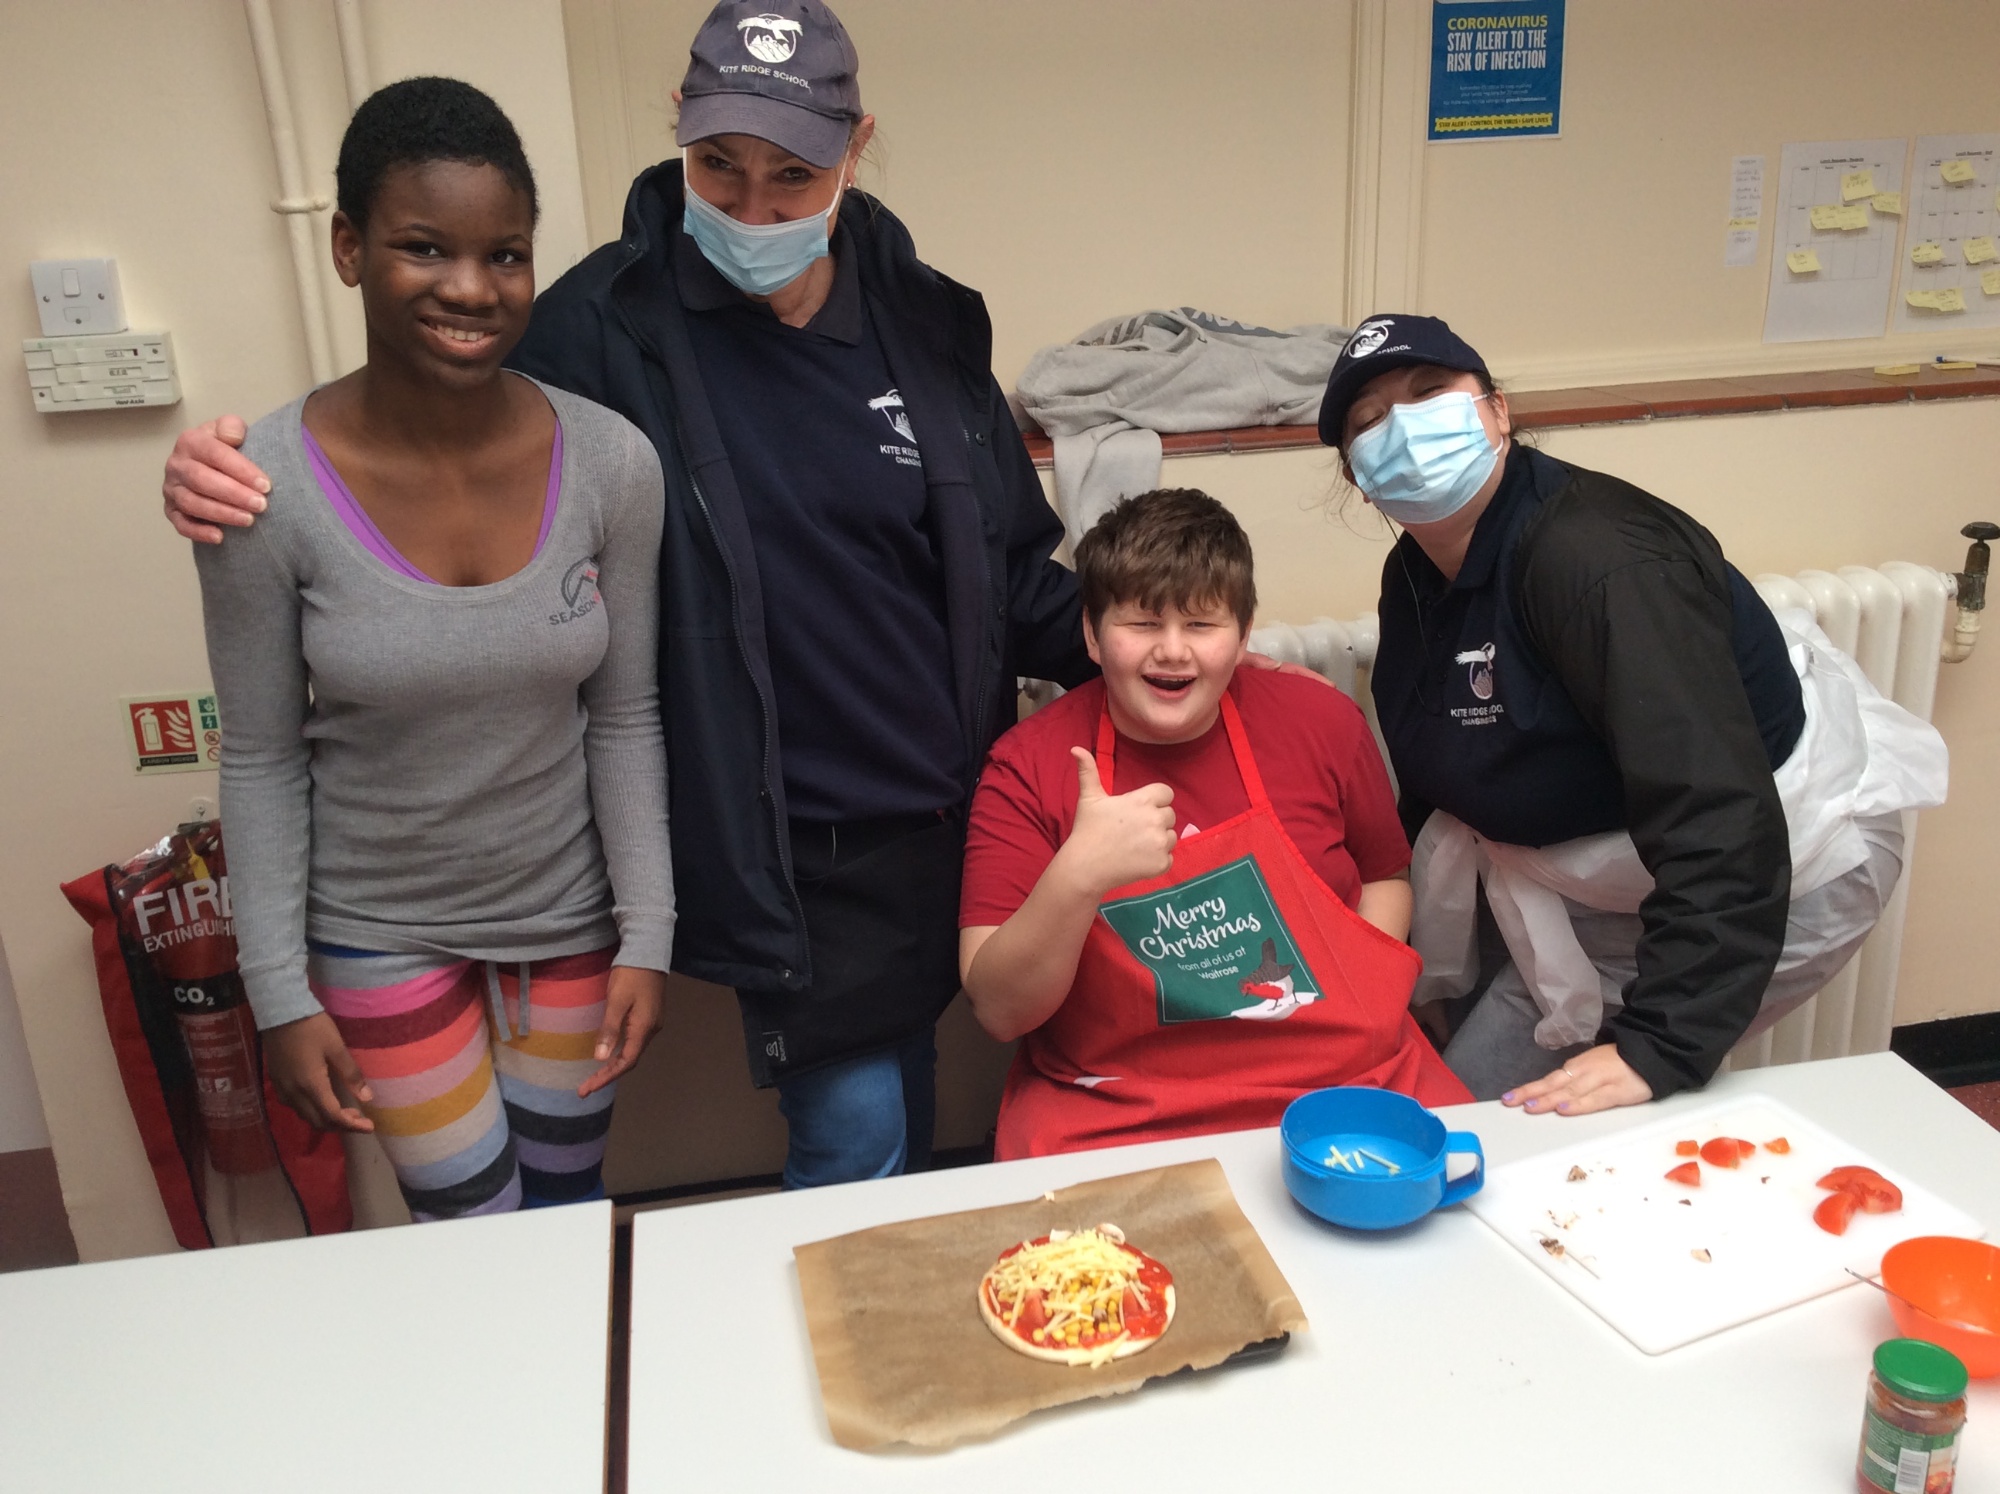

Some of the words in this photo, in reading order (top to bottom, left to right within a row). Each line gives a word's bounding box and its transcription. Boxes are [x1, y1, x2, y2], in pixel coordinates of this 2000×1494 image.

[1447, 15, 1548, 31] CORONAVIRUS
[1447, 32, 1474, 51] STAY
[1475, 31, 1508, 50] ALERT
[1511, 30, 1525, 49] TO
[1527, 29, 1547, 48] THE
[1446, 52, 1472, 72] RISK
[1474, 51, 1488, 71] OF
[1490, 49, 1546, 70] INFECTION
[719, 65, 739, 74] KITE
[741, 64, 771, 76] RIDGE
[773, 70, 810, 89] SCHOOL
[1451, 120, 1467, 128] ALERT
[1470, 118, 1493, 127] CONTROL
[1503, 117, 1519, 126] VIRUS
[1521, 116, 1535, 125] SAVE
[1534, 116, 1549, 124] LIVES
[880, 444, 901, 455] KITE
[1450, 708, 1468, 717] KITE
[1153, 897, 1226, 935] Merry
[1140, 912, 1261, 960] Christmas
[1177, 962, 1200, 971] from
[1200, 957, 1212, 969] all
[1211, 954, 1223, 966] of
[1222, 952, 1235, 962] us
[1234, 945, 1247, 958] at
[1198, 965, 1239, 979] Waitrose
